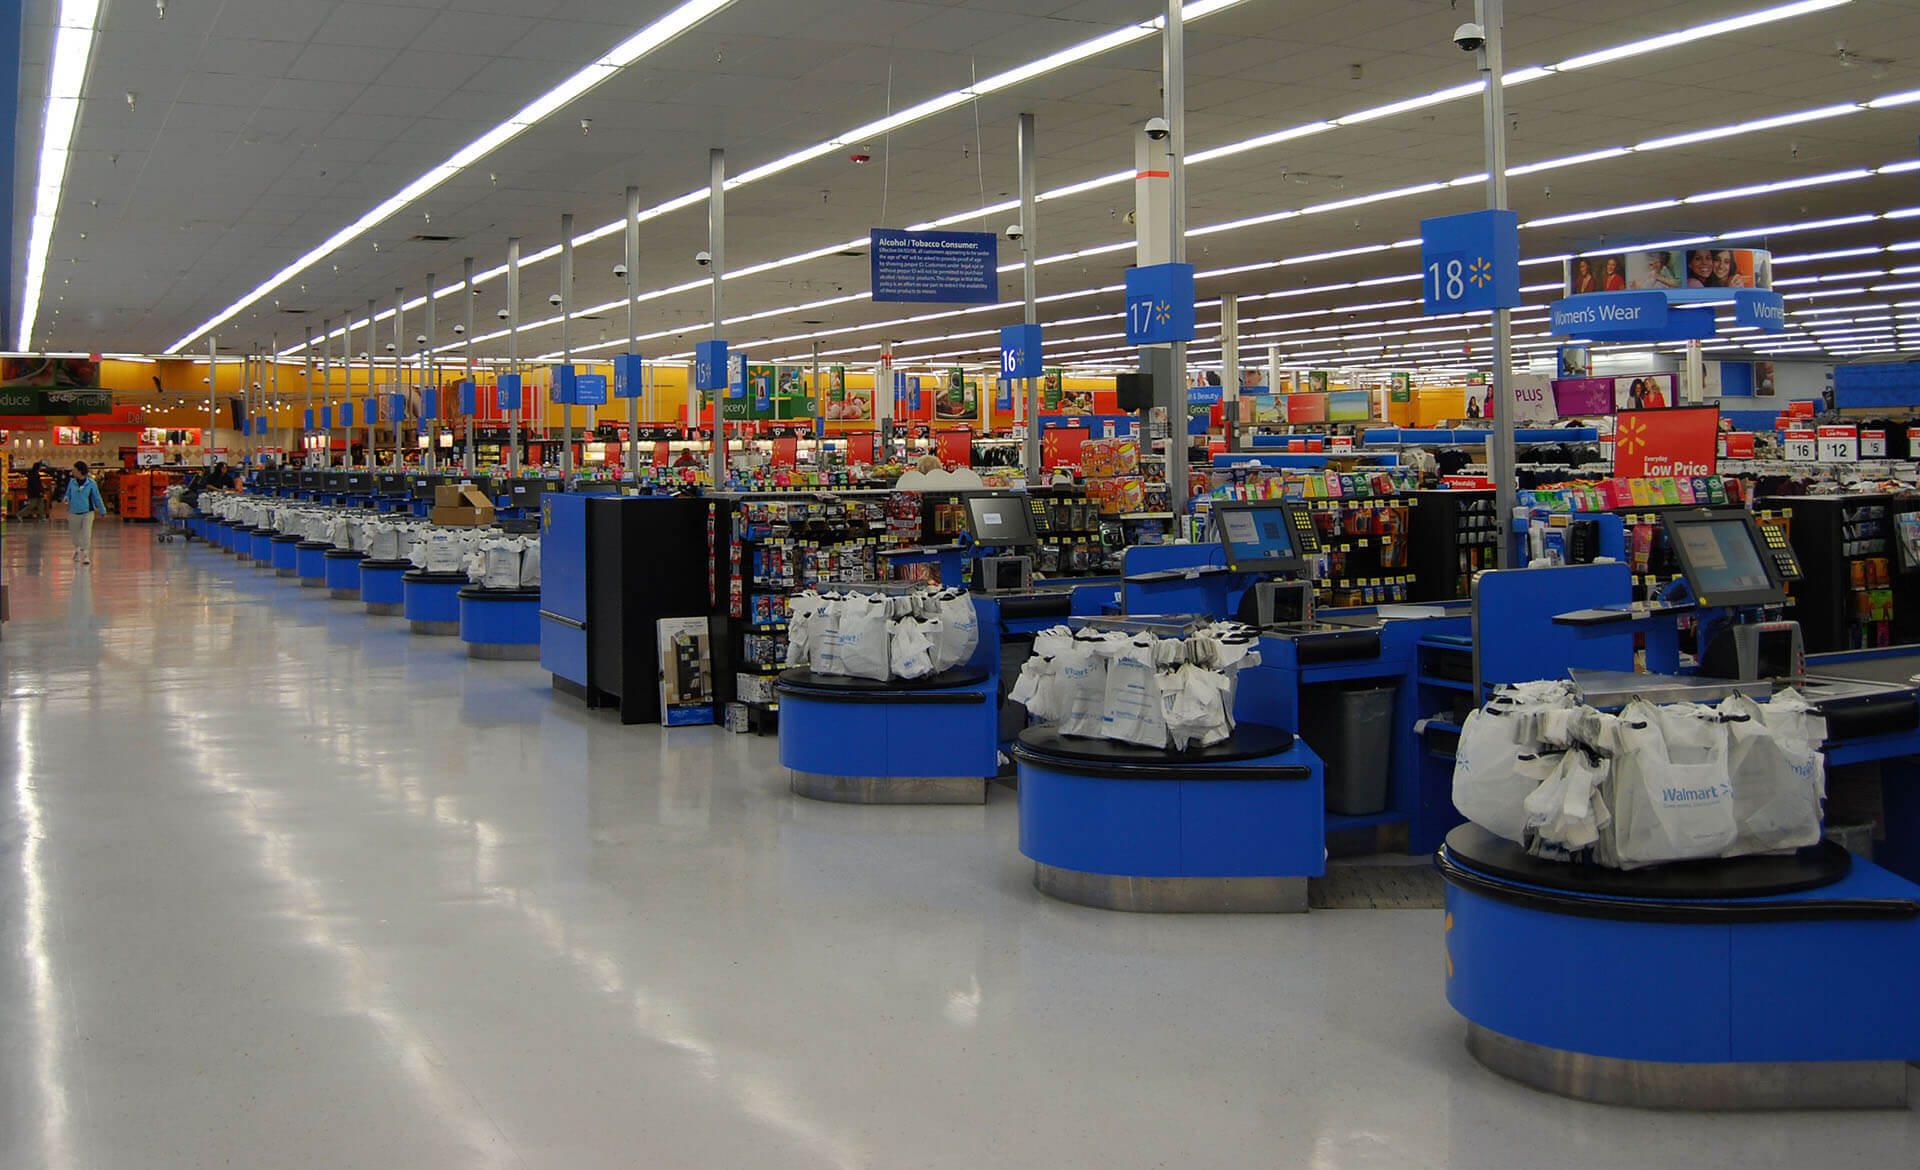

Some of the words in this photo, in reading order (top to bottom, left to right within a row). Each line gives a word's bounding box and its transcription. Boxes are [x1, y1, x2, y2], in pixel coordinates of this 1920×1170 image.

[911, 240, 940, 248] Tobacco
[941, 240, 979, 249] Consumer:
[1429, 260, 1464, 300] 18
[1130, 301, 1153, 334] 17
[1554, 305, 1596, 327] Women's
[1599, 304, 1641, 321] Wear
[1002, 349, 1016, 372] 16
[697, 362, 705, 384] 15
[1198, 392, 1219, 402] Beauty
[1515, 388, 1543, 402] PLUS
[1827, 444, 1847, 457] $12
[1644, 462, 1671, 476] Low
[1674, 460, 1708, 476] Price
[1662, 786, 1719, 801] Walmart
